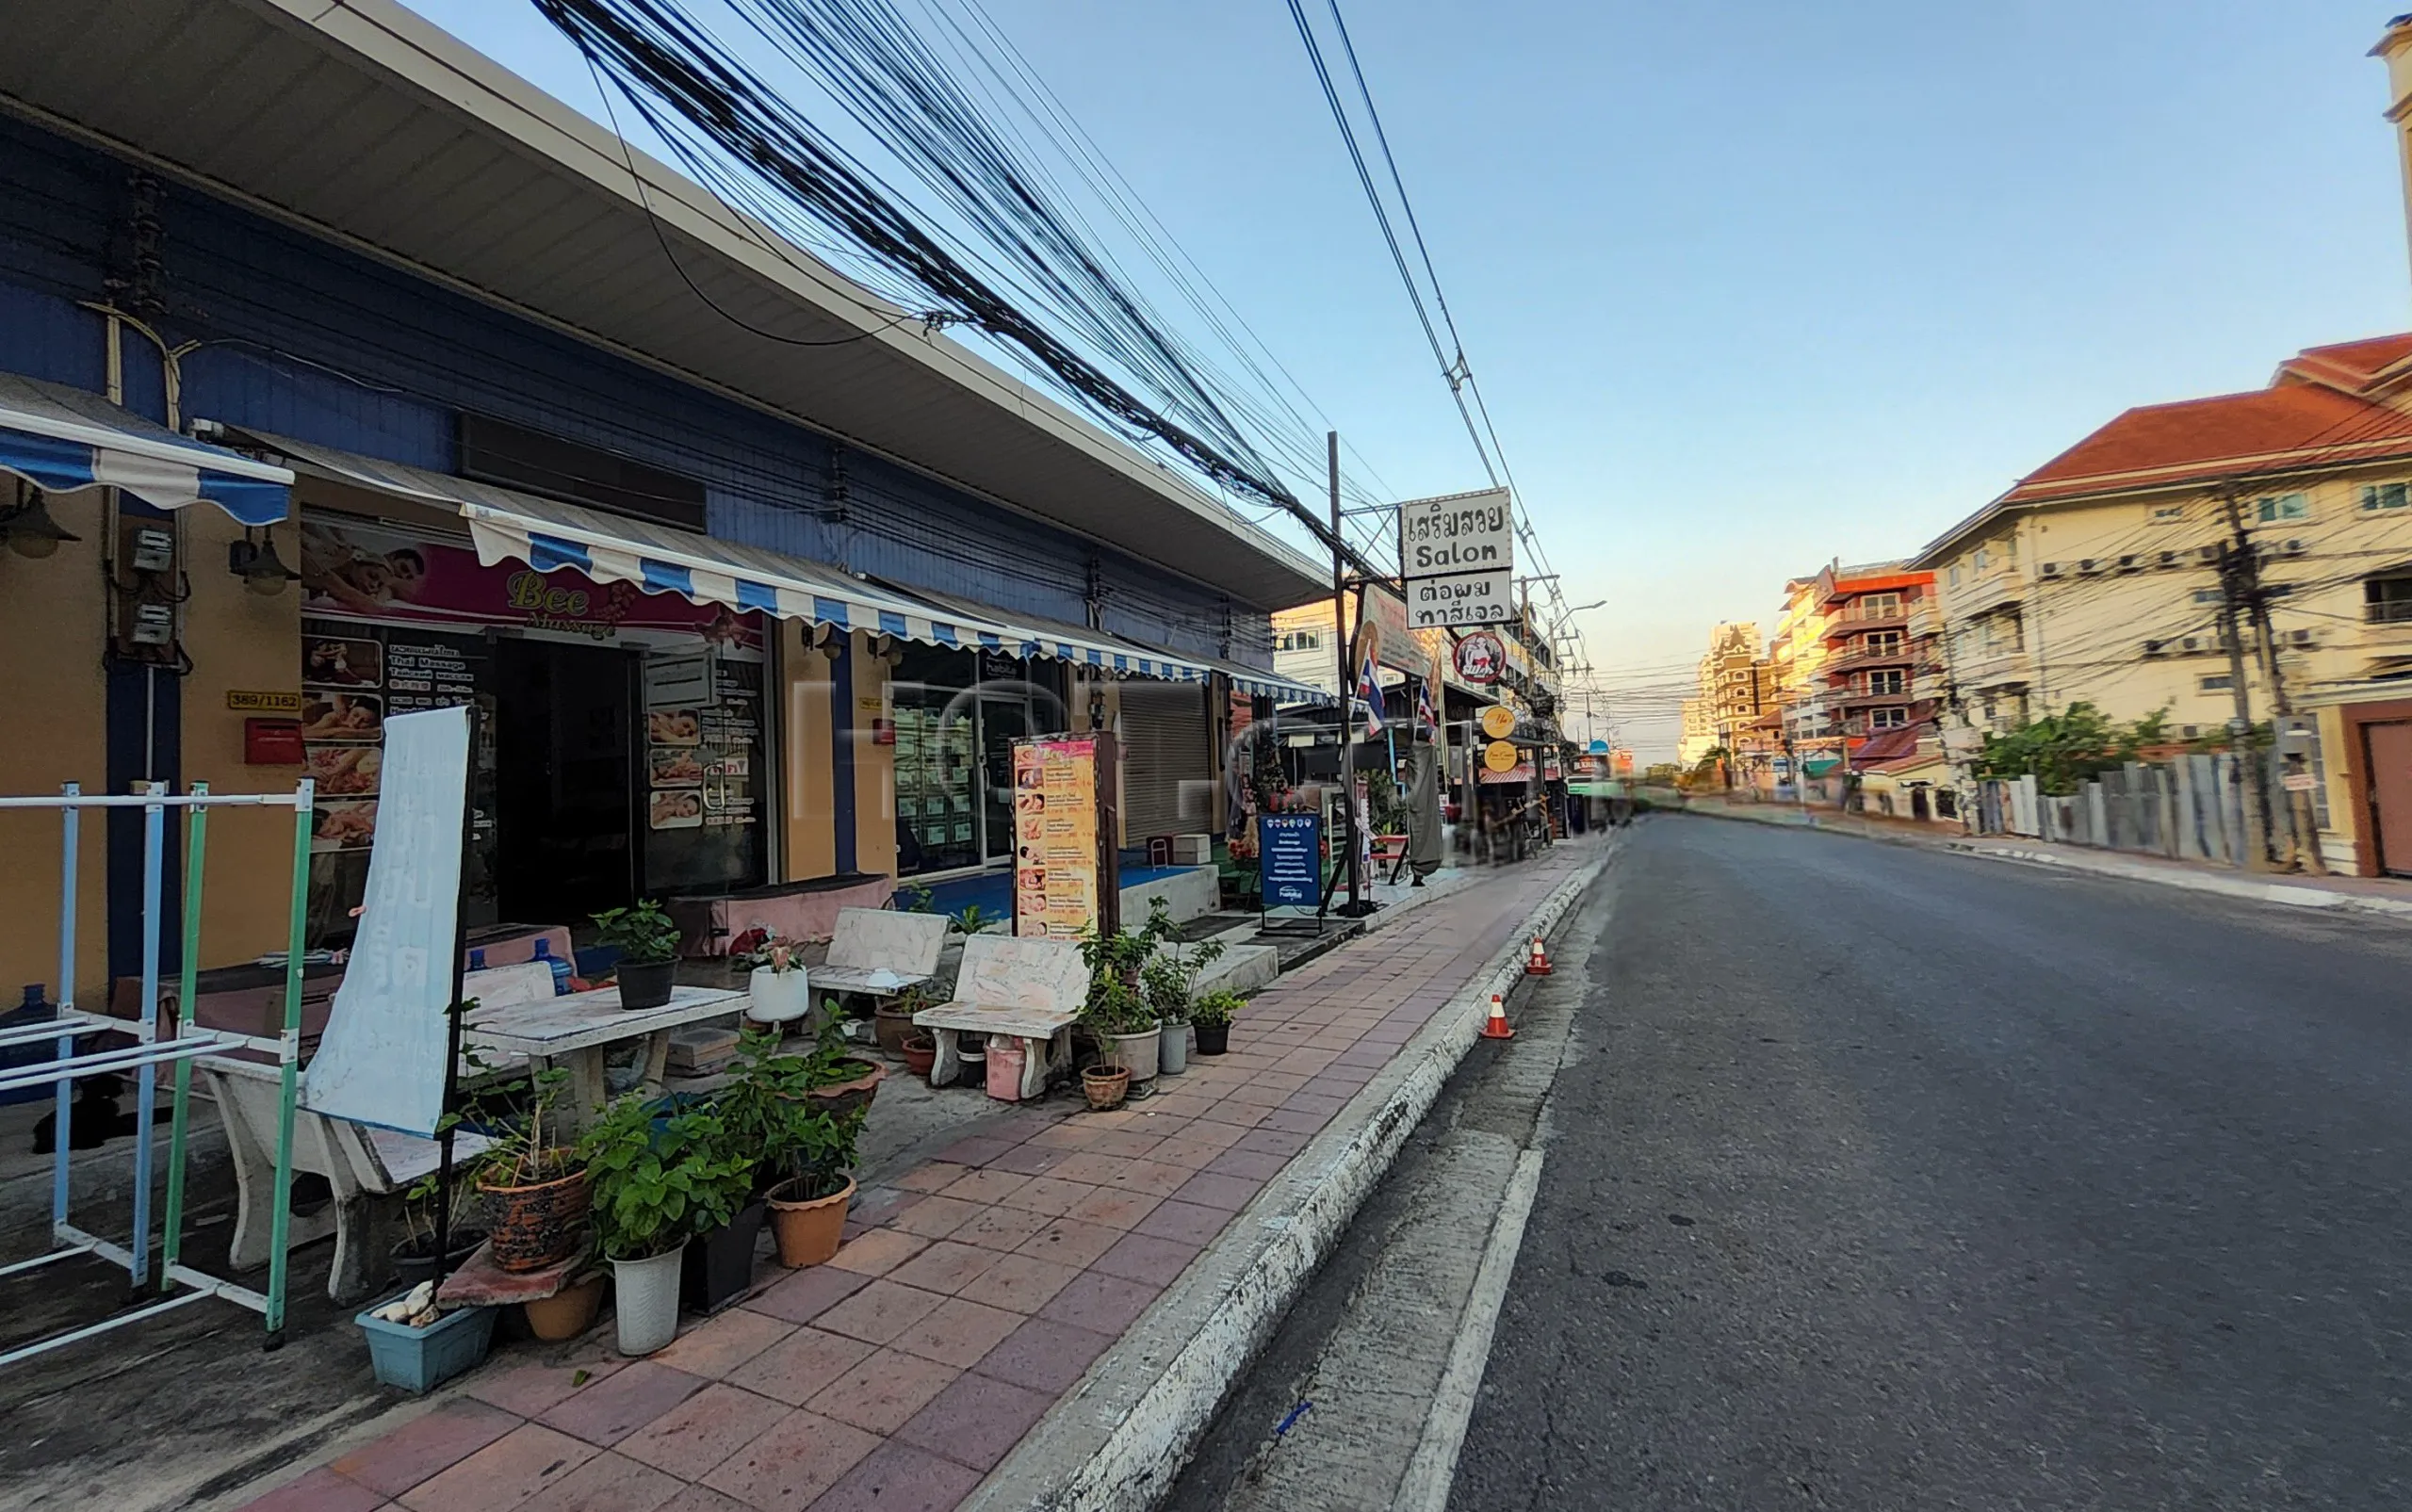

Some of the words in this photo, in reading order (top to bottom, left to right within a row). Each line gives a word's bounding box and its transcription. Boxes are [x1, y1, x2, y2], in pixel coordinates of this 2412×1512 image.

[1408, 503, 1505, 542] เสริมสวย
[1416, 542, 1498, 568] Salon
[506, 569, 590, 617] Bee
[1420, 578, 1491, 602] ต่อผม
[528, 611, 616, 641] Massage
[1415, 600, 1505, 624] ทาสีเจล
